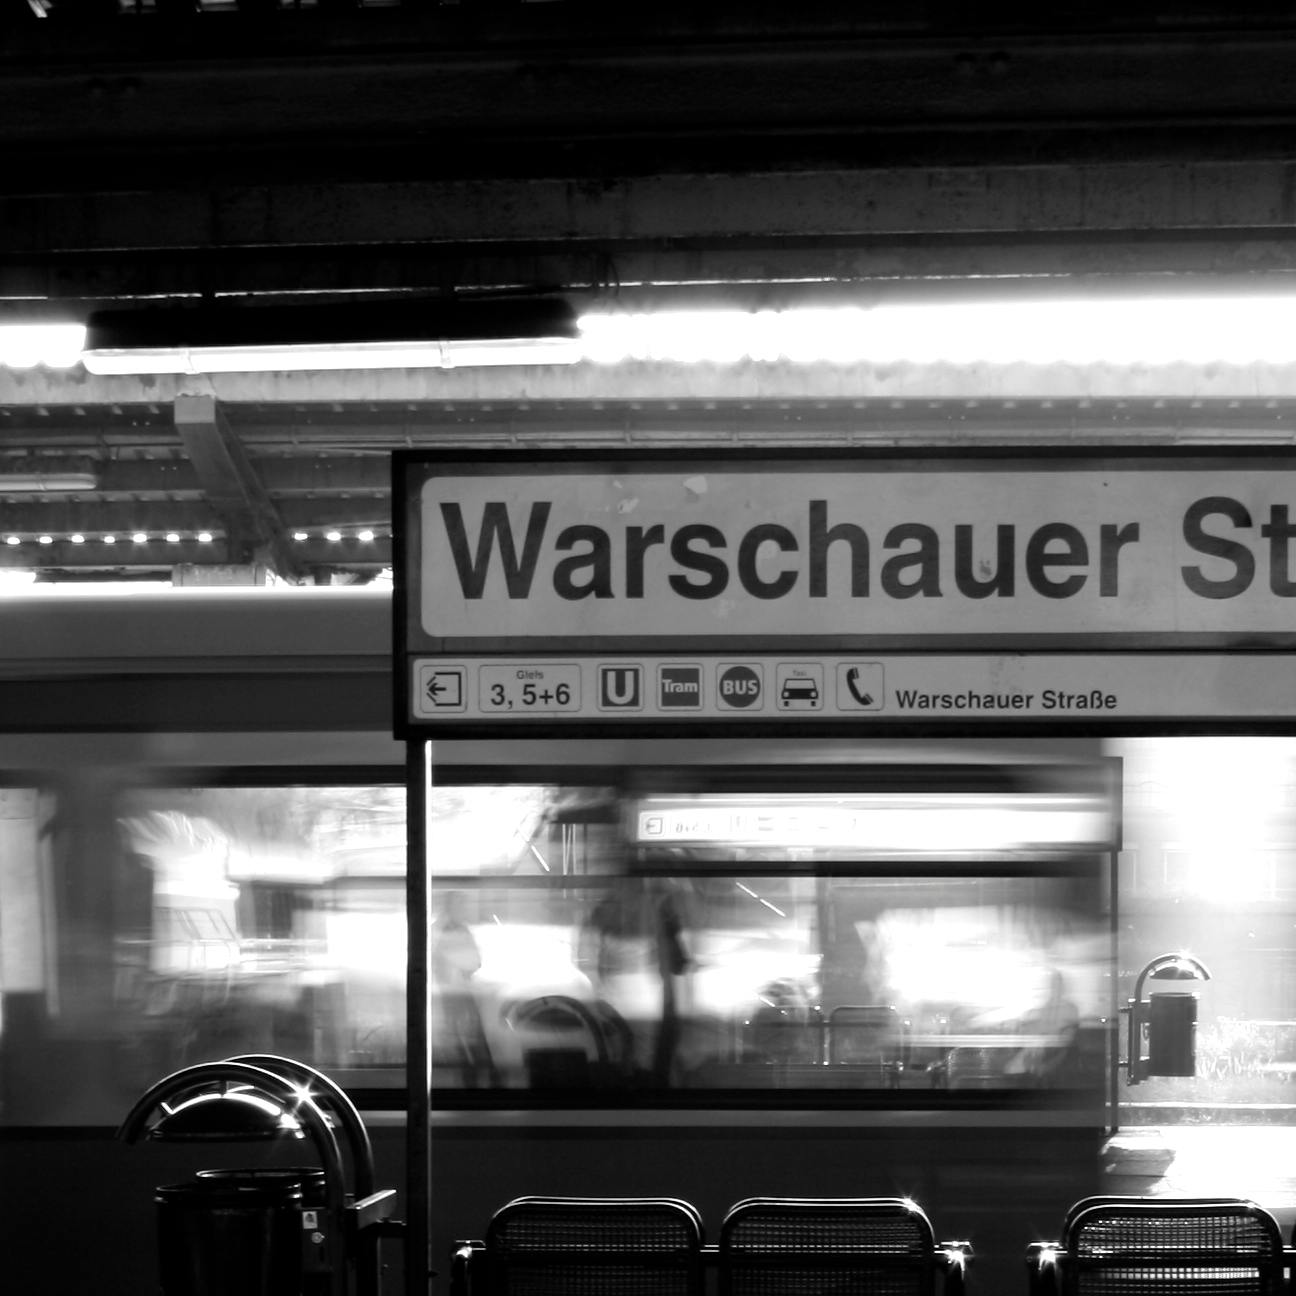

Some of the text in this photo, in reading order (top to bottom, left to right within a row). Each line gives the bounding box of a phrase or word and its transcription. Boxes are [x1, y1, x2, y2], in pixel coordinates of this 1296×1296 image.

[439, 499, 1140, 601] Warschauer
[491, 683, 571, 709] 3, 5+6
[606, 670, 635, 705] U
[662, 679, 698, 693] Tram
[722, 680, 758, 695] BUS
[895, 689, 1117, 709] Warschauer Straße
